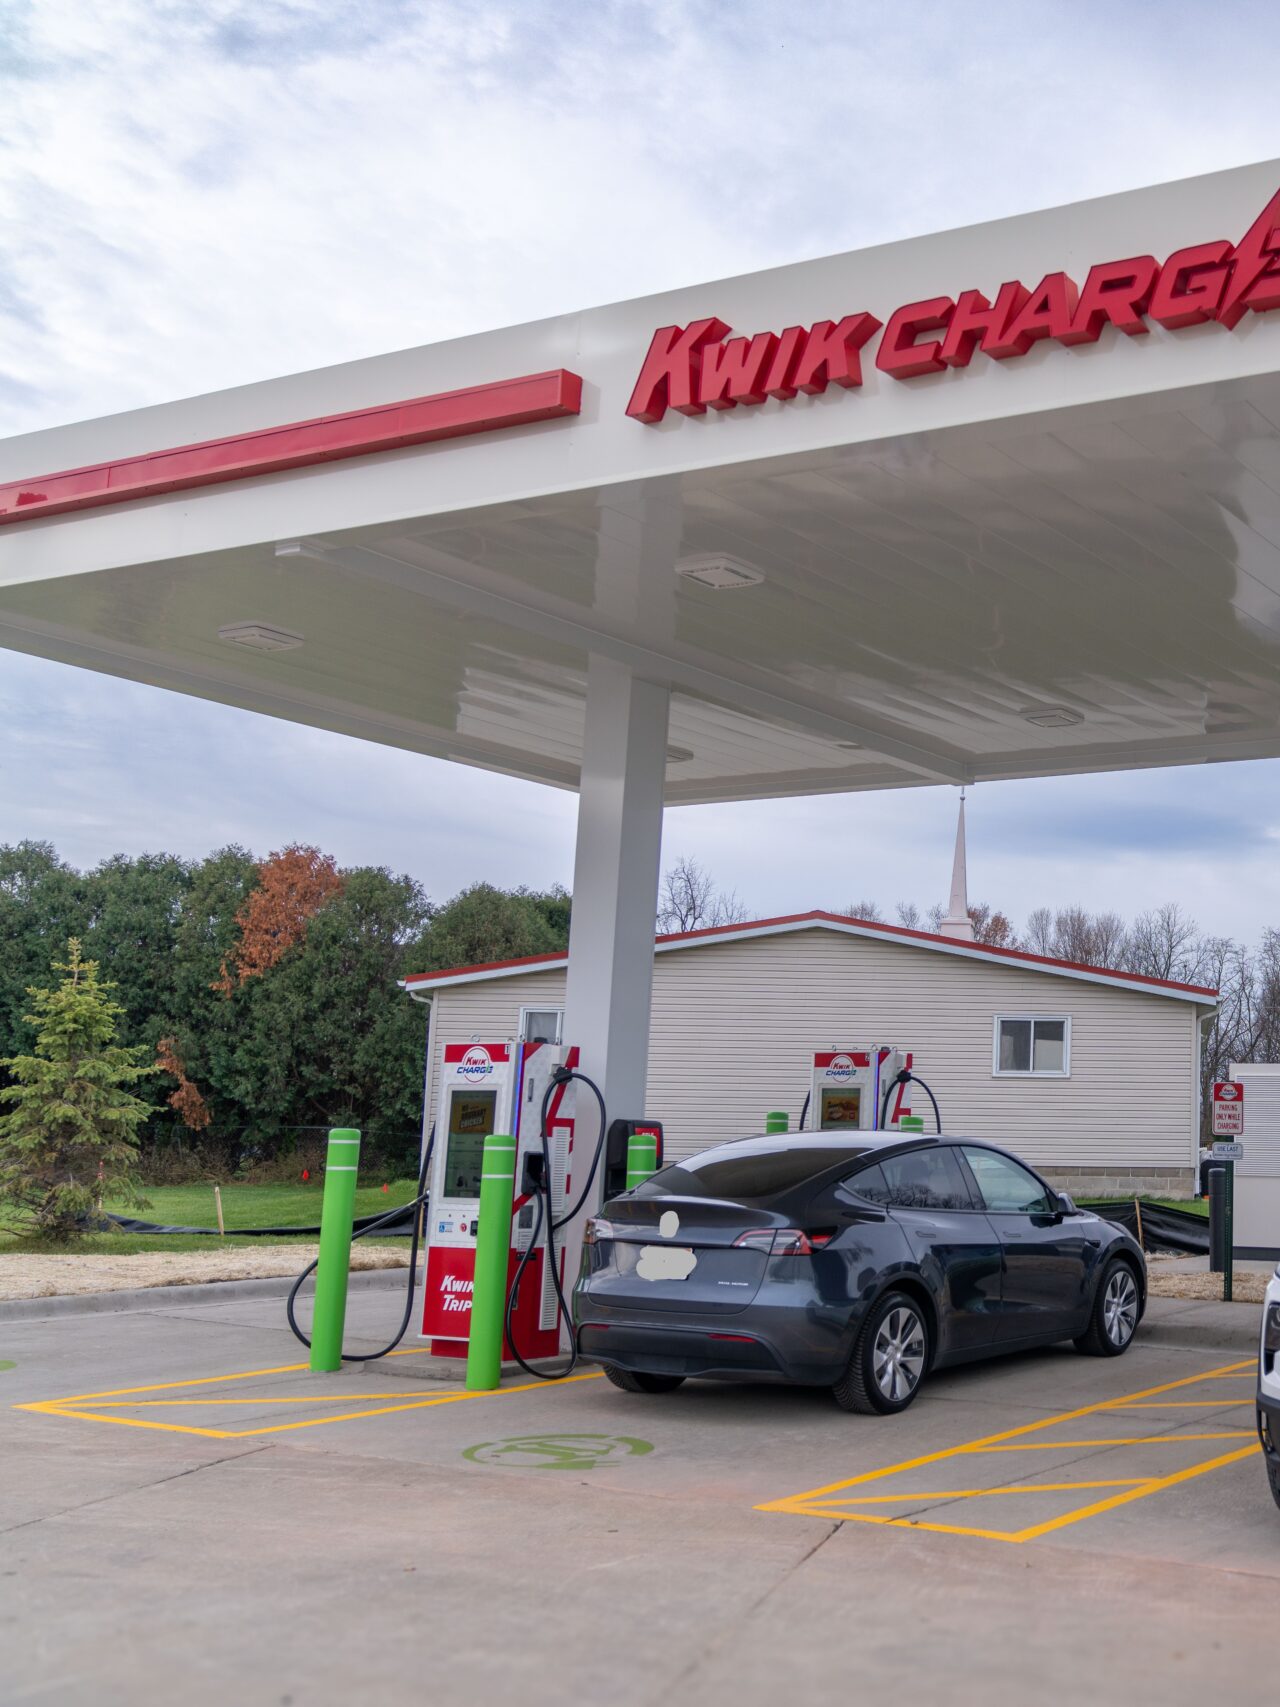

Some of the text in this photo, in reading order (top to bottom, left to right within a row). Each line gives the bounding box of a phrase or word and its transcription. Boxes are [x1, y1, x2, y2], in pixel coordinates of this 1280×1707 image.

[625, 311, 882, 425] KWIK
[465, 1056, 487, 1066] KWIK
[1218, 1104, 1238, 1112] PARKING
[1215, 1113, 1241, 1121] ONLY WHILE
[1217, 1122, 1240, 1130] CHARGING
[442, 1294, 473, 1312] TRIP
